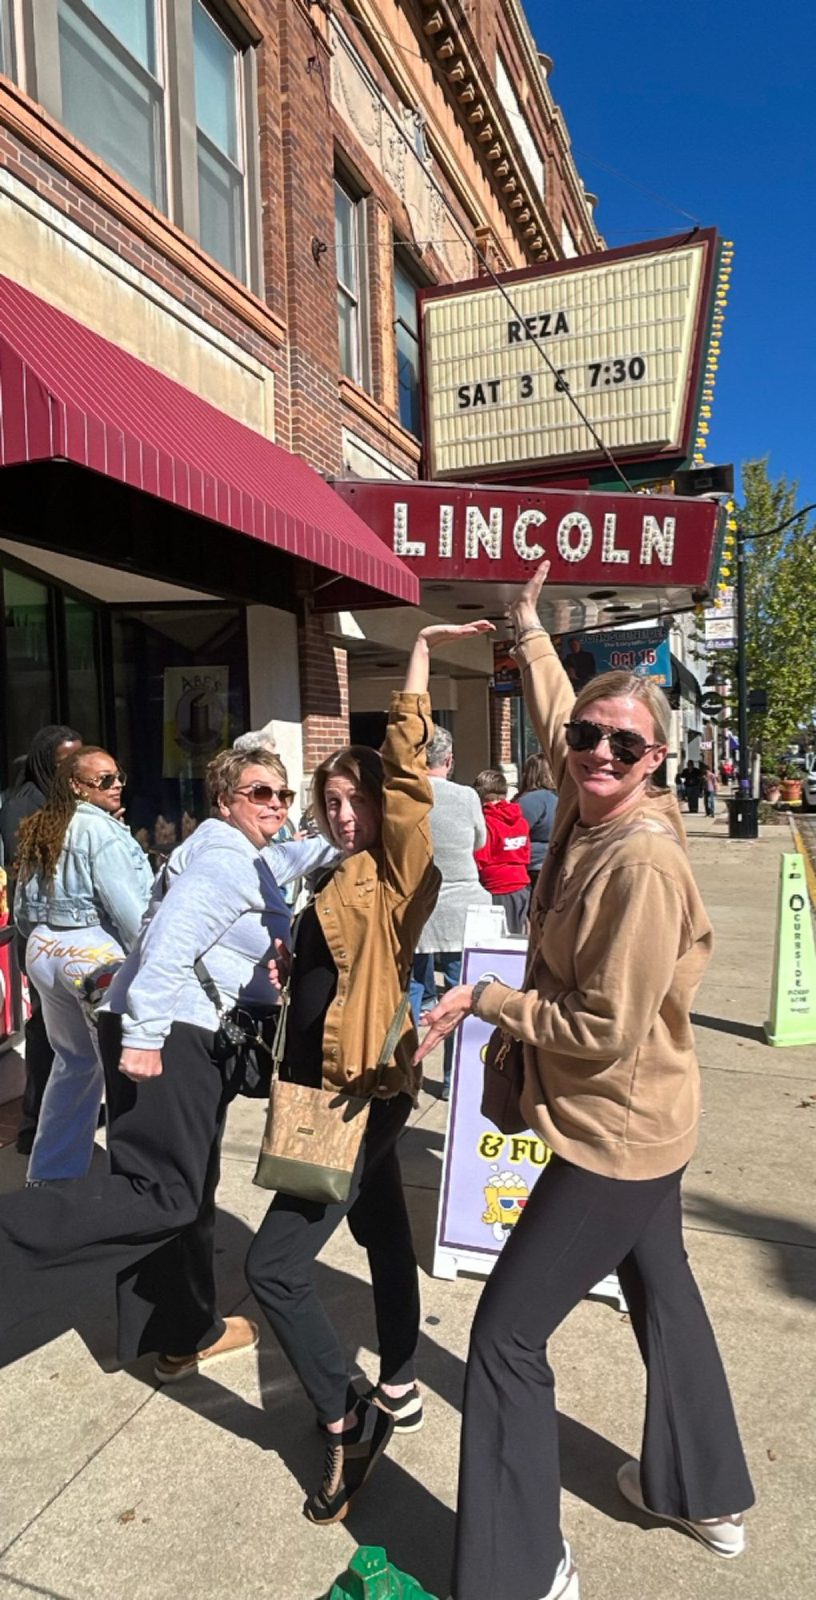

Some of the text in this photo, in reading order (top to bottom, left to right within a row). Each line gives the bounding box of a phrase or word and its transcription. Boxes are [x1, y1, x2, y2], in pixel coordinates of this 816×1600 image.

[508, 310, 570, 344] REZA
[457, 357, 646, 409] SAT 3 & 7:30
[393, 502, 677, 567] LINCOLN
[610, 648, 658, 667] Oct 16
[793, 913, 802, 987] CURBSIDE
[479, 1134, 504, 1158] &
